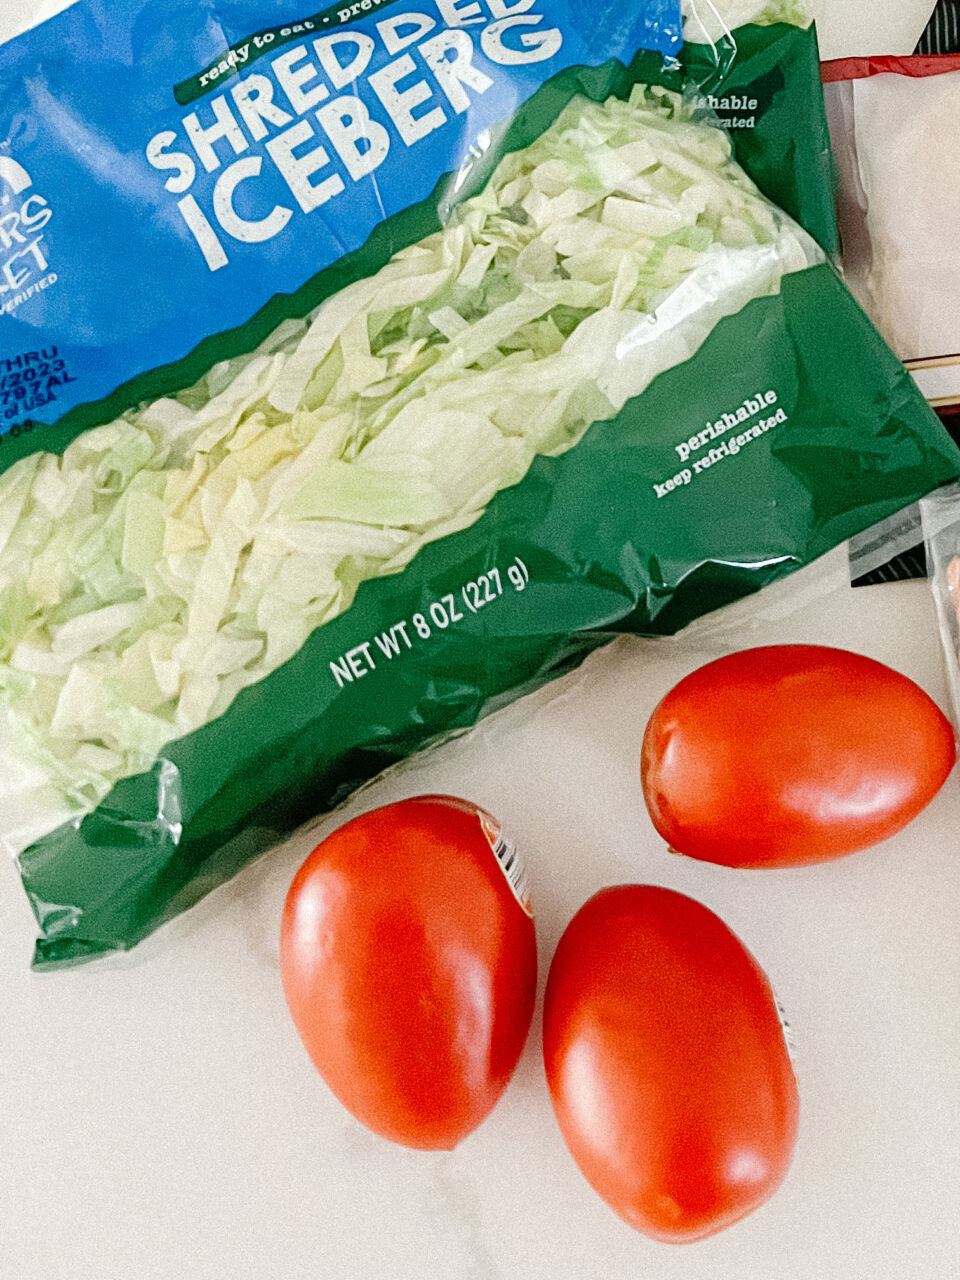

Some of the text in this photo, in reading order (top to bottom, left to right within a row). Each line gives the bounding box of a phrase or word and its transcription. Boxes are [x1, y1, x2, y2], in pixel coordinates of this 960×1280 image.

[198, 40, 250, 88] ready
[253, 28, 275, 48] to
[280, 19, 315, 37] eat
[176, 14, 563, 273] ICEBERG
[653, 407, 788, 498] keep refrigerated
[675, 388, 778, 461] perishable
[329, 557, 529, 688] NET WT 8 OZ (227 g)
